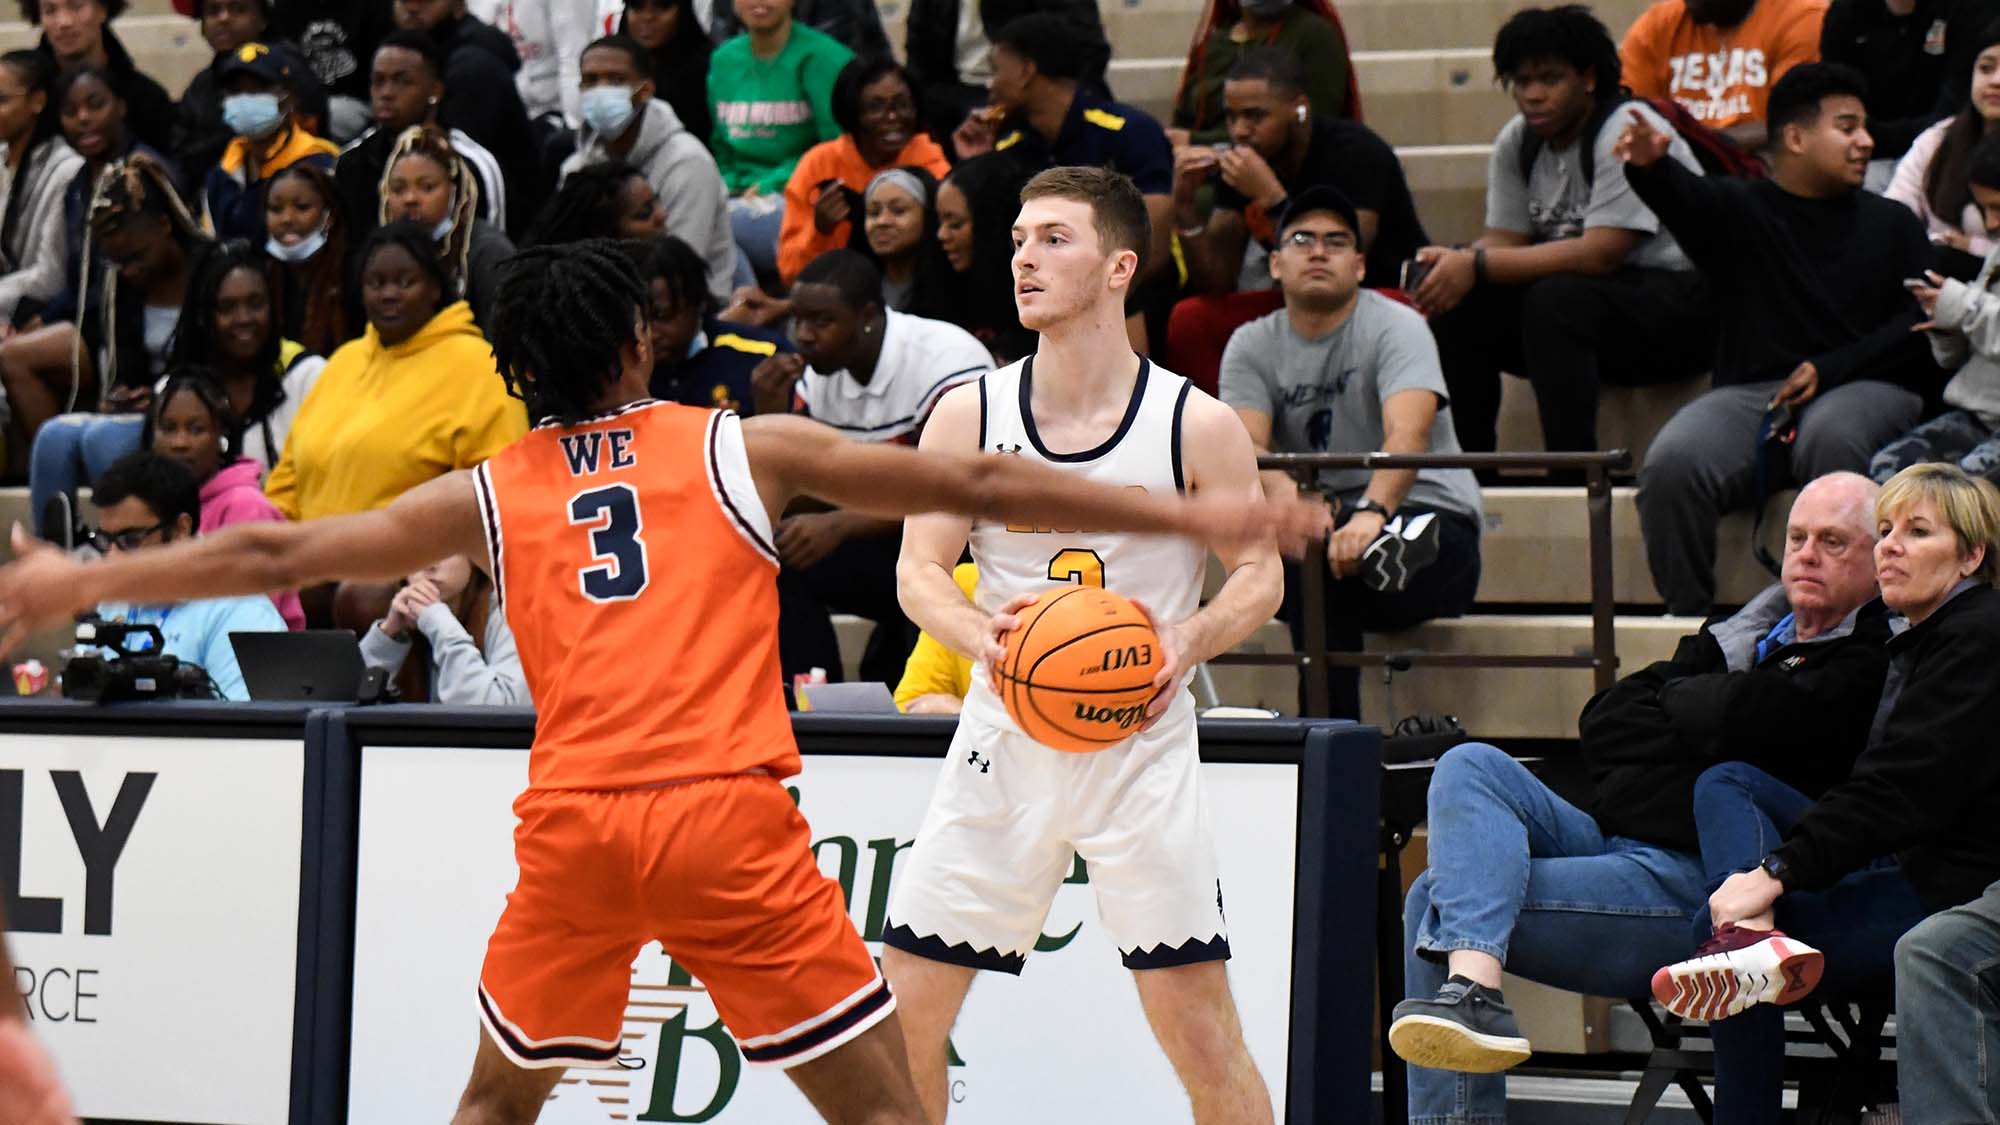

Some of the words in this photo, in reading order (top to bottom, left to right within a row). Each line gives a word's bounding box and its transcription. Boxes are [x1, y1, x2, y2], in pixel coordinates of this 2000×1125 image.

[1668, 47, 1768, 95] TEXAS
[560, 429, 637, 477] WE
[567, 481, 650, 603] 3
[1075, 701, 1147, 730] ilson
